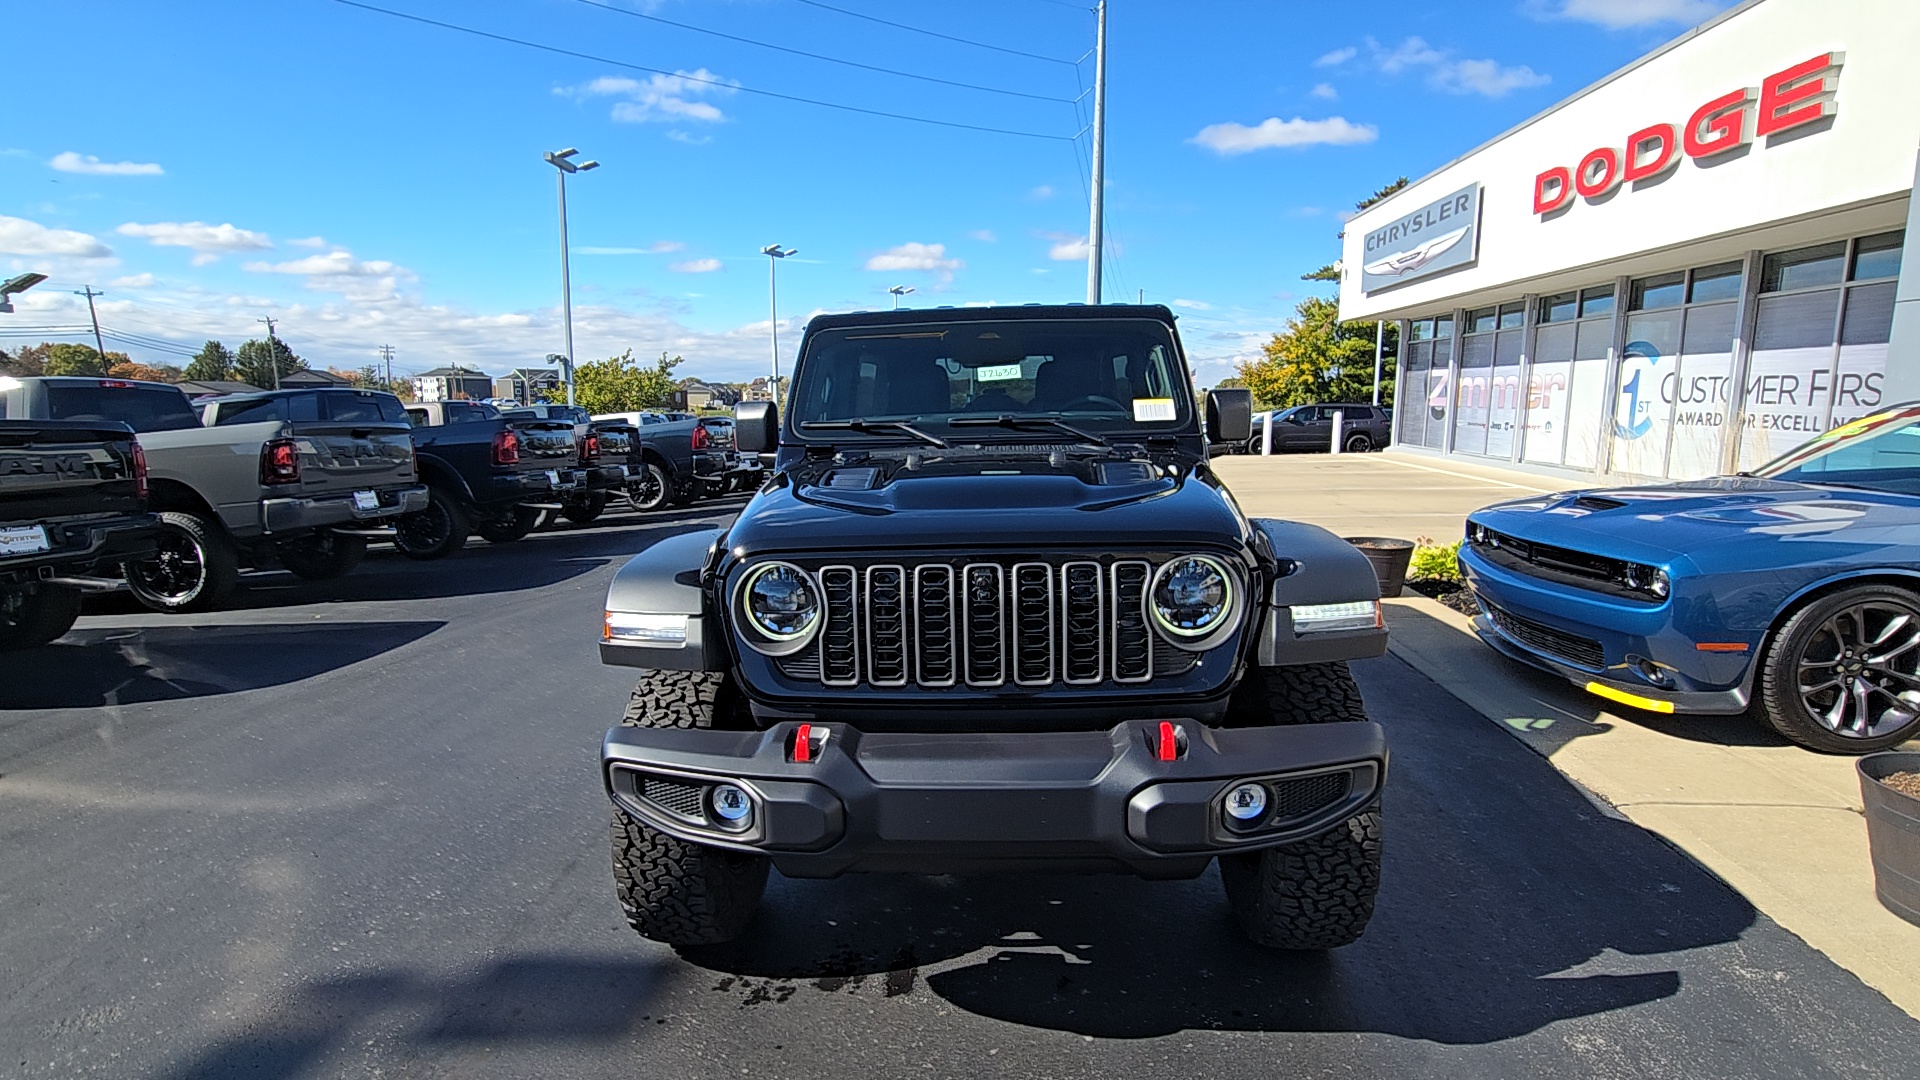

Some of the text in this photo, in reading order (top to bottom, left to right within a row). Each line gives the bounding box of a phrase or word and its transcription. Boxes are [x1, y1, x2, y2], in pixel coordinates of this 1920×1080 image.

[1533, 51, 1843, 215] DODGE
[1366, 193, 1470, 252] CHRYSLER
[1428, 371, 1566, 410] Zmmer
[1675, 411, 1723, 428] AWARD
